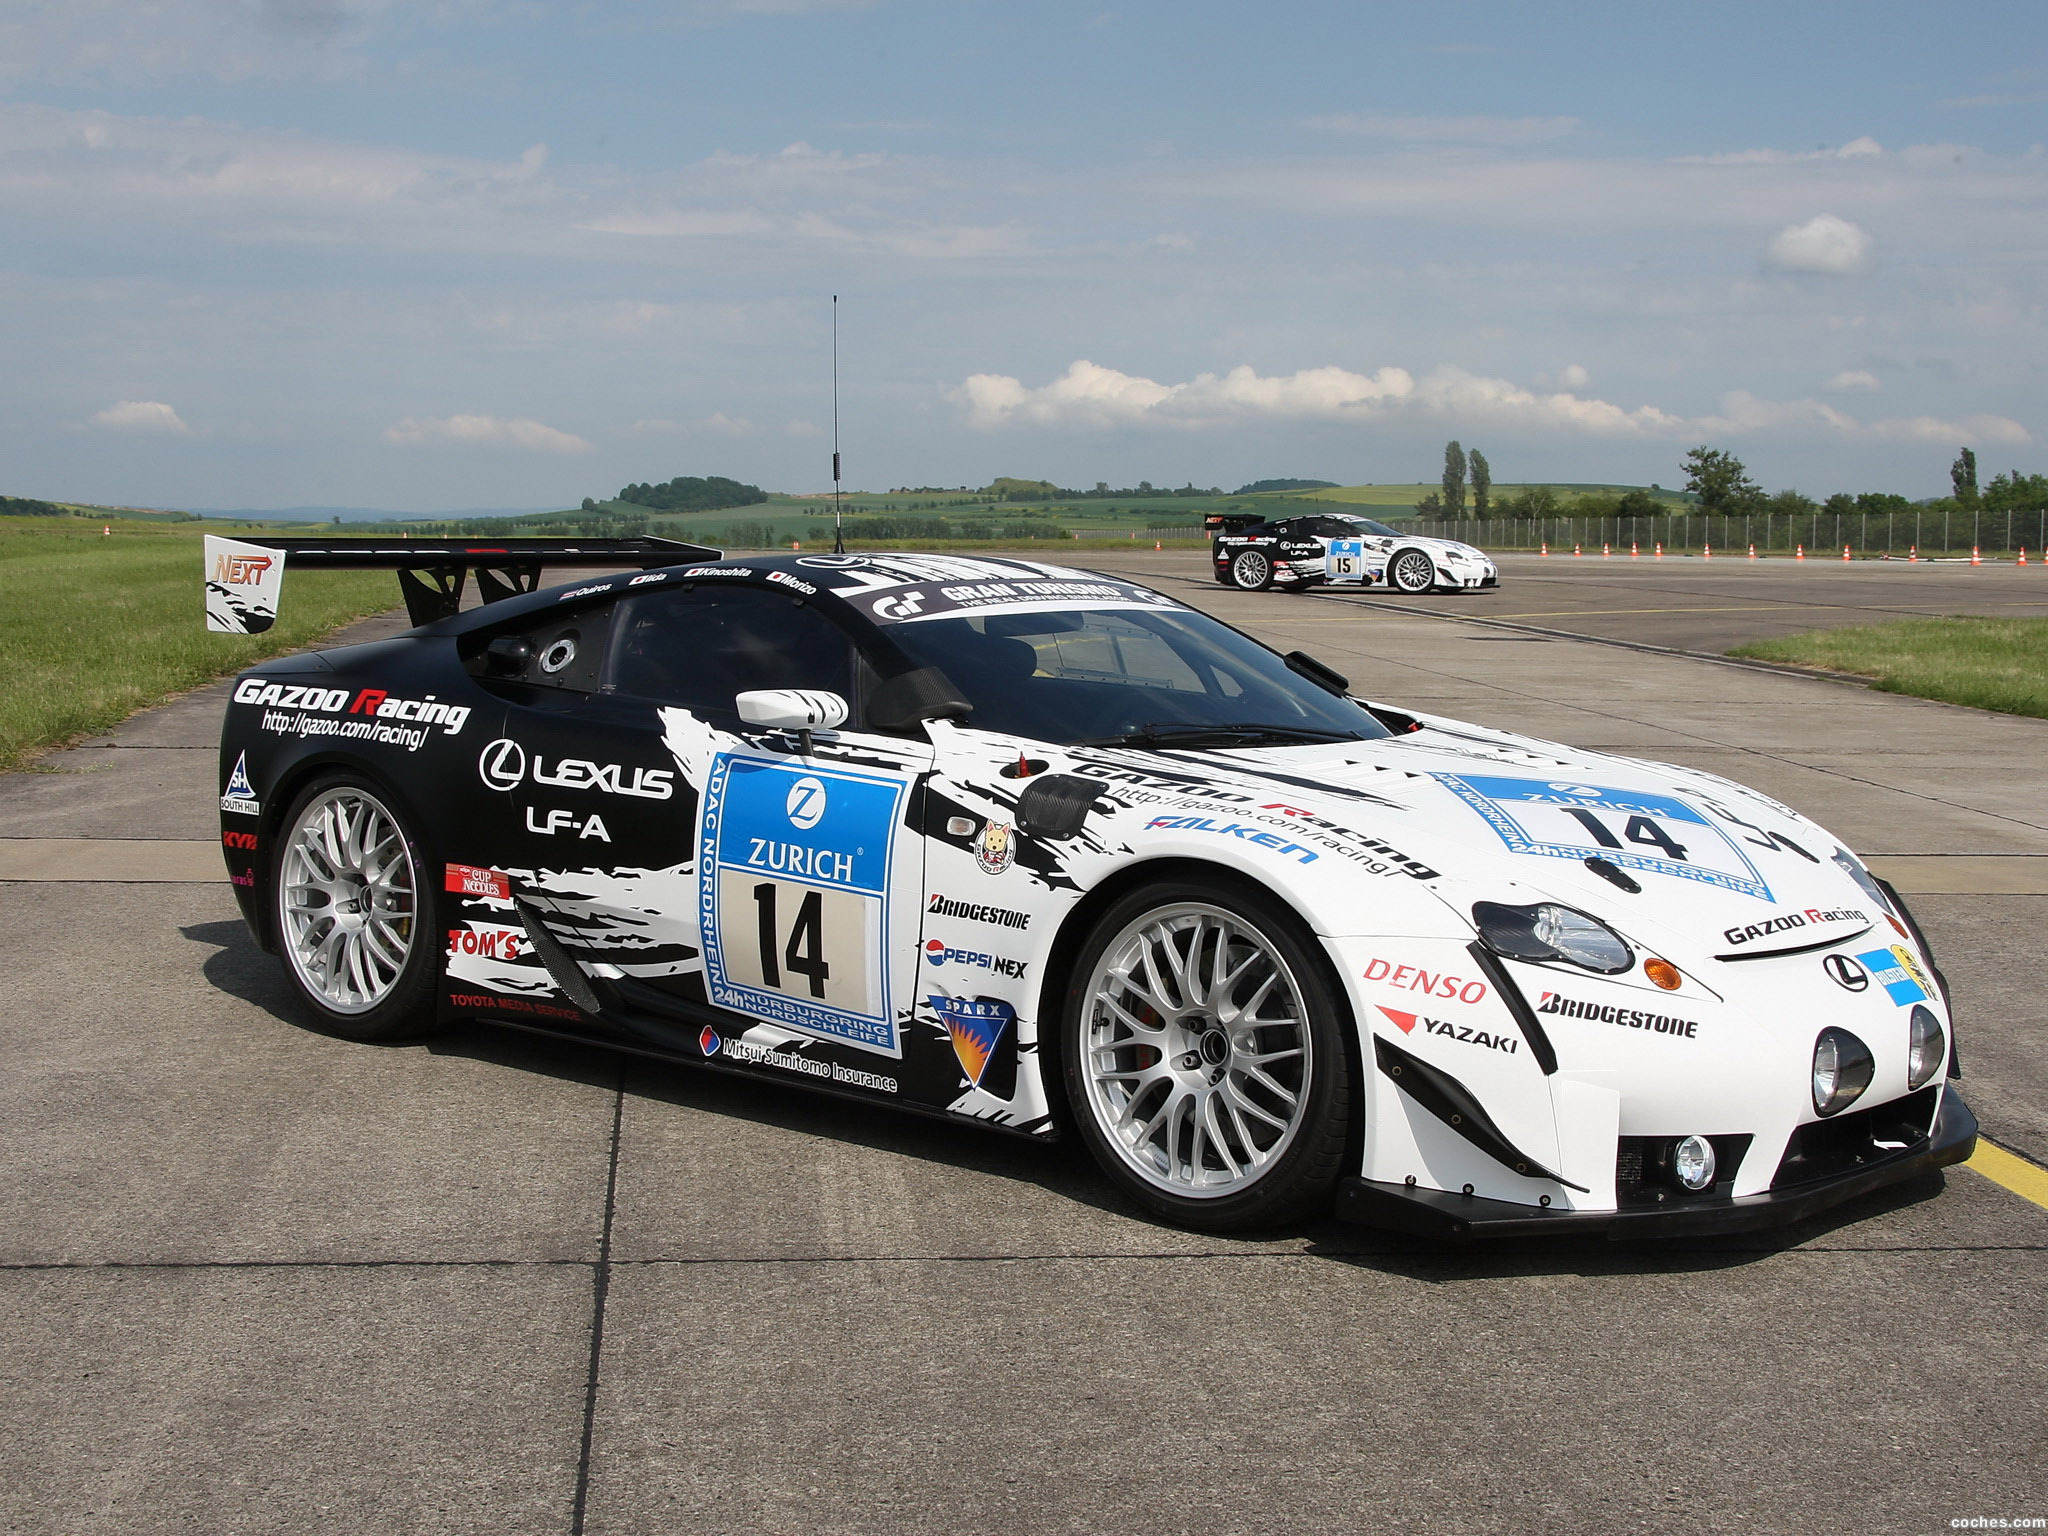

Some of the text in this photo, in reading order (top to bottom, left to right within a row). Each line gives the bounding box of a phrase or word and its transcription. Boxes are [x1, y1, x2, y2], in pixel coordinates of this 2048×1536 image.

[211, 553, 272, 585] NEXT
[700, 567, 752, 577] Kinoshita
[1337, 558, 1351, 573] 15
[780, 574, 817, 595] Morizo
[940, 583, 1121, 600] GRAN TURISMO
[234, 679, 472, 735] GAZOO Racing
[262, 709, 430, 752] http://gazoo.com/racing/
[533, 755, 674, 800] LEXUS
[221, 798, 259, 814] SOUTH HILL
[1071, 763, 1442, 880] GAZOO Racing
[1459, 790, 1524, 843] NORDRHEIN
[1522, 792, 1670, 818] ZURICH
[526, 806, 612, 843] LF-A
[1111, 786, 1402, 878] http://gazoo.com/racing/
[1143, 815, 1319, 864] FALKEN
[1559, 807, 1689, 861] 14
[748, 838, 854, 883] ZURICH
[1510, 843, 1560, 857] 24h
[463, 879, 500, 896] NOODLES
[472, 869, 491, 883] CUP
[702, 758, 727, 985] ADAC NORDRHEIN
[927, 893, 1031, 930] BRIDGESTONE
[1723, 907, 1870, 945] GAZOO Racing
[448, 929, 519, 960] TOM'S
[753, 882, 830, 1000] 14
[943, 947, 1029, 980] PEPSI NEX
[1363, 958, 1487, 1004] DENSO
[450, 994, 581, 1021] TOYOTA MEDIA SERVICE
[714, 987, 745, 1009] 24h
[945, 999, 1001, 1016] SPARX
[1537, 991, 1698, 1038] BRIDGESTONE
[745, 1001, 890, 1046] NORDSCHLEIFE
[1422, 1017, 1518, 1054] YAZAKI
[723, 1038, 898, 1093] Mitsui Sumitomo Insurance
